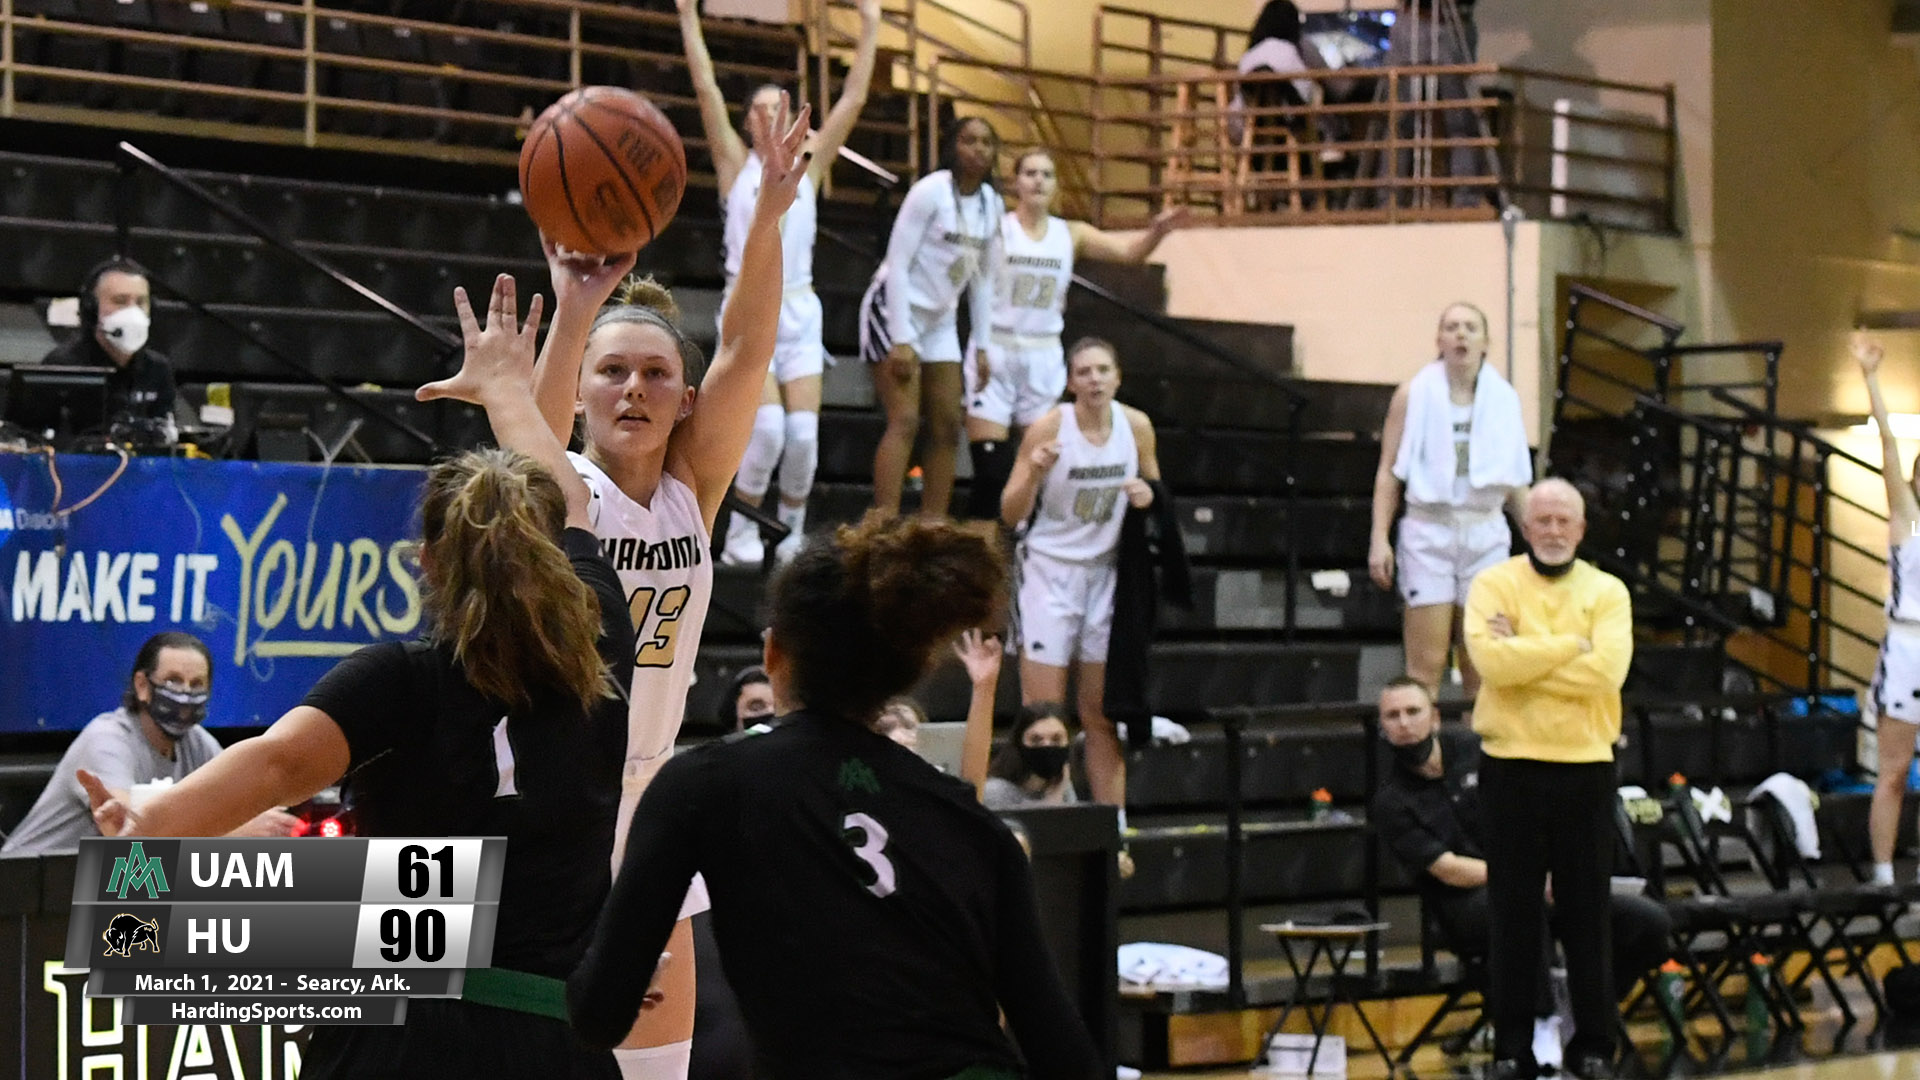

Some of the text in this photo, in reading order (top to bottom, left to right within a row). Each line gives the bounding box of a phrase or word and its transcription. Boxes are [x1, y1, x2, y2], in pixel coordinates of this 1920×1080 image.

[12, 492, 422, 666] MAKE IT YOURS
[627, 584, 691, 668] 13
[493, 716, 519, 797] 1
[843, 811, 897, 897] 3
